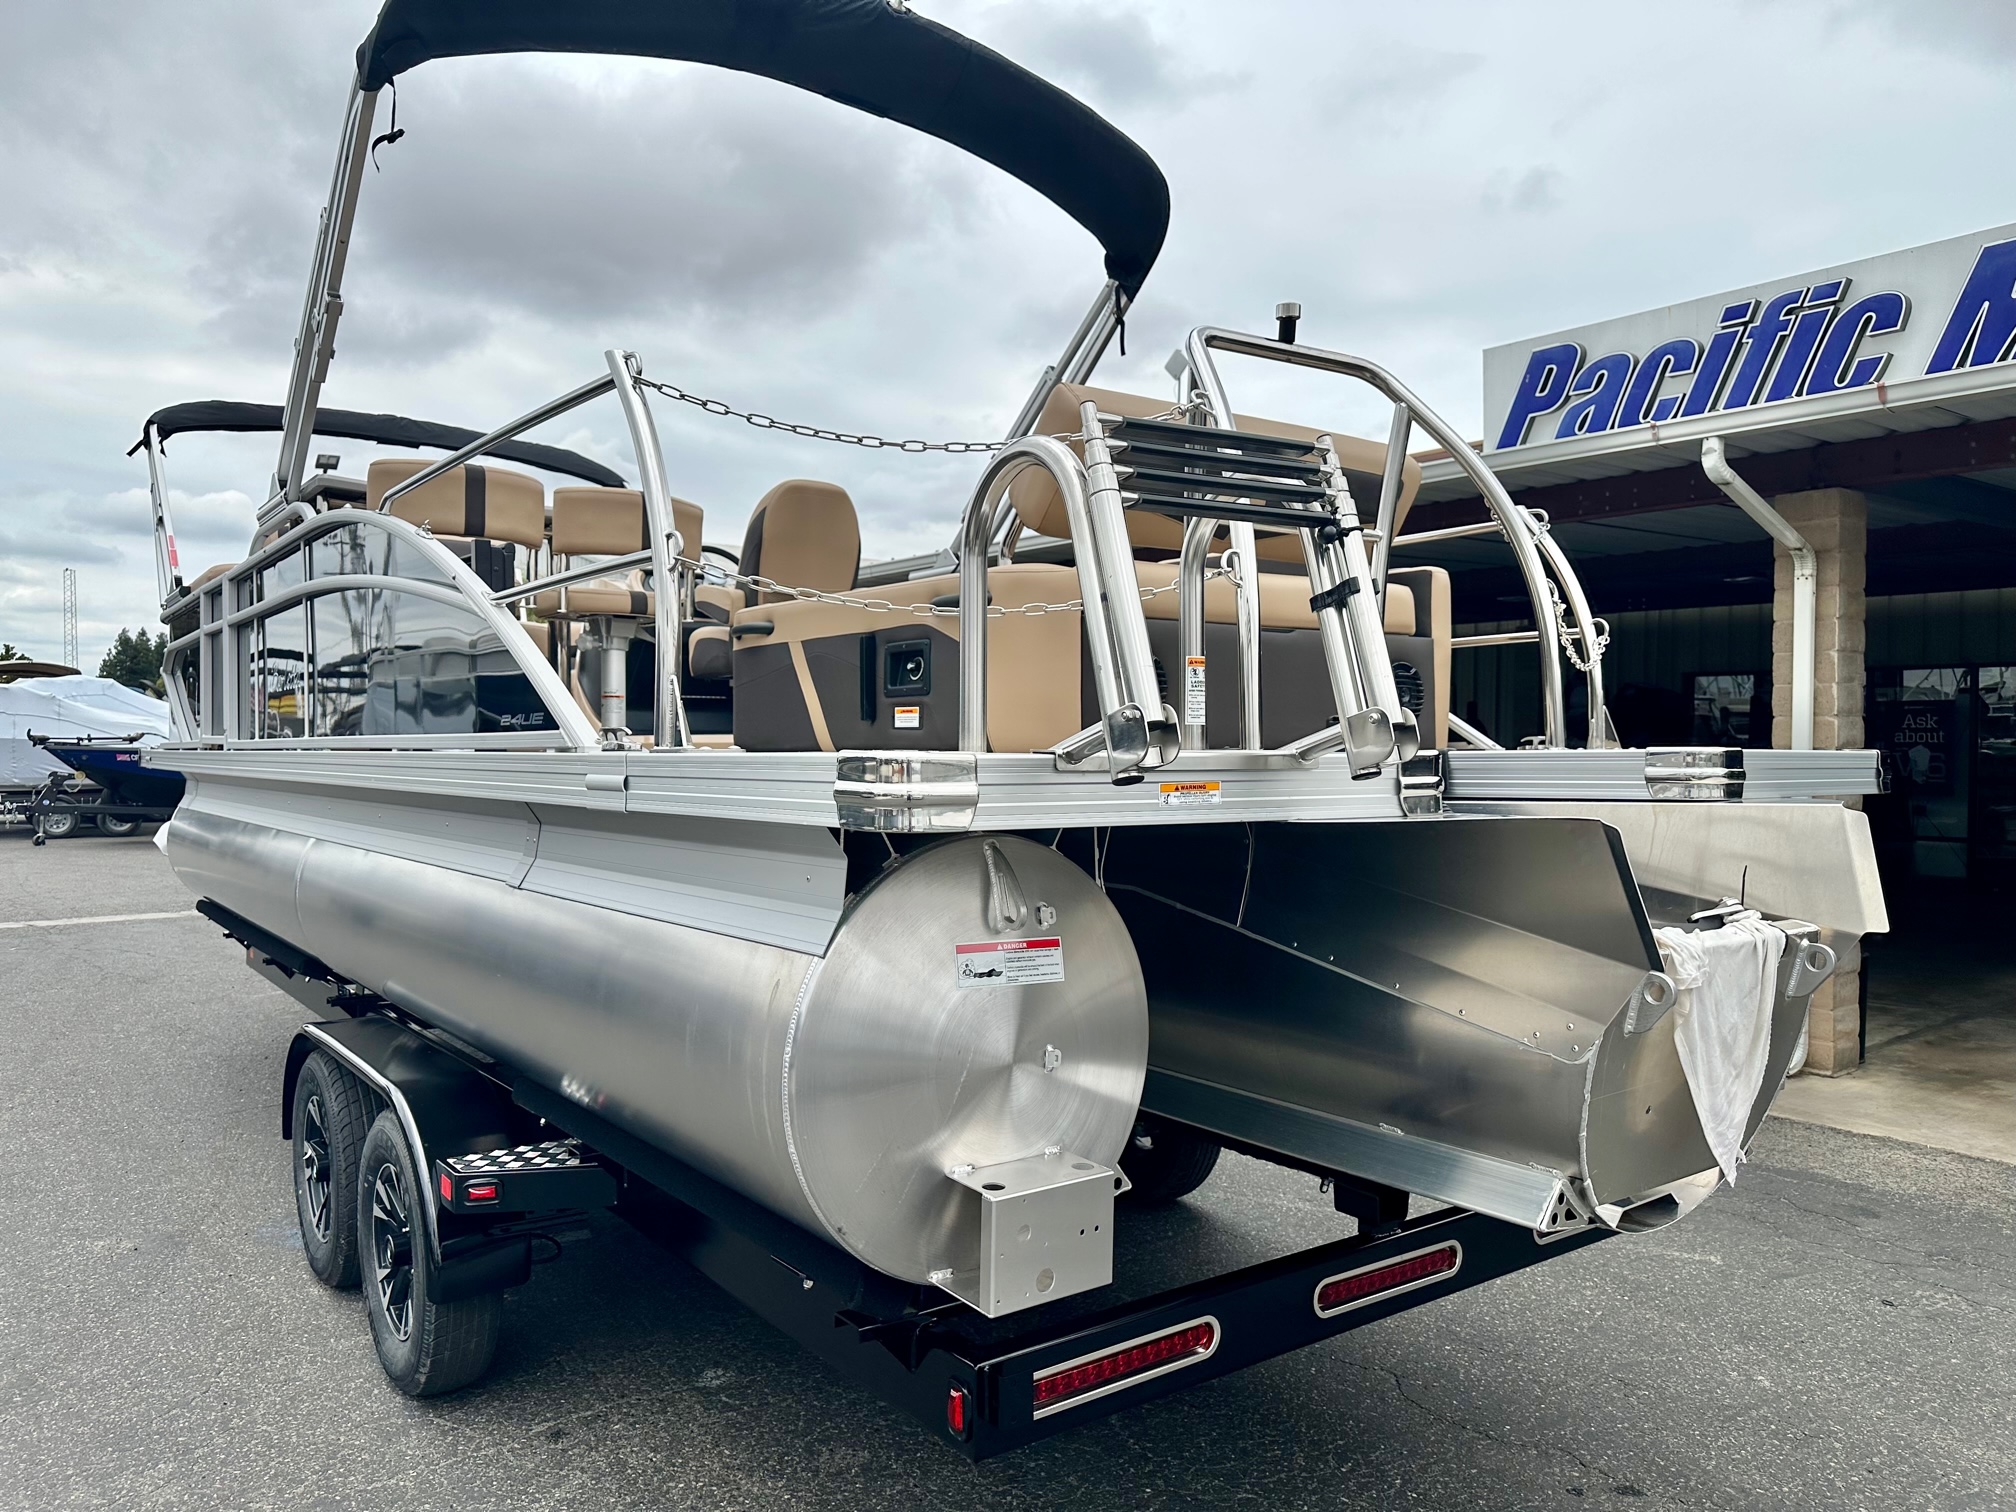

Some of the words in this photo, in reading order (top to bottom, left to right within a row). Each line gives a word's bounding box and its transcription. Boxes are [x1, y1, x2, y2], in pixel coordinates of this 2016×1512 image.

[1496, 277, 1910, 450] Pacific
[1902, 713, 1939, 728] Ask
[1894, 730, 1945, 743] about
[1003, 942, 1028, 950] DANGER
